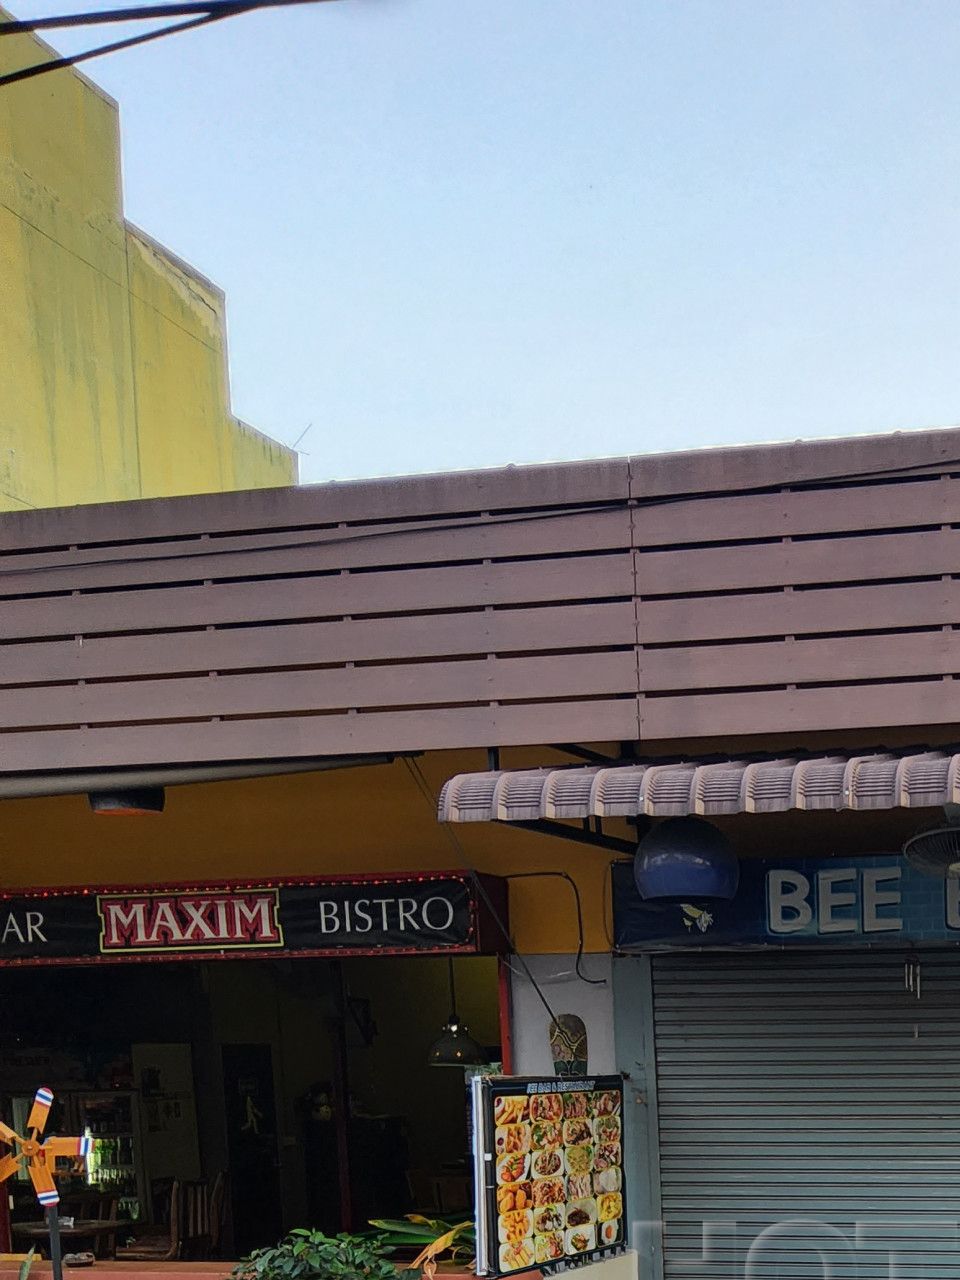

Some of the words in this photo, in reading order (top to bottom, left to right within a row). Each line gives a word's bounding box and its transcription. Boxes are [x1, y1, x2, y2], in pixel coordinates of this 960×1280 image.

[1, 911, 48, 944] AR
[105, 898, 278, 944] MAXIM
[319, 896, 455, 934] BISTRO
[766, 867, 902, 933] BEE
